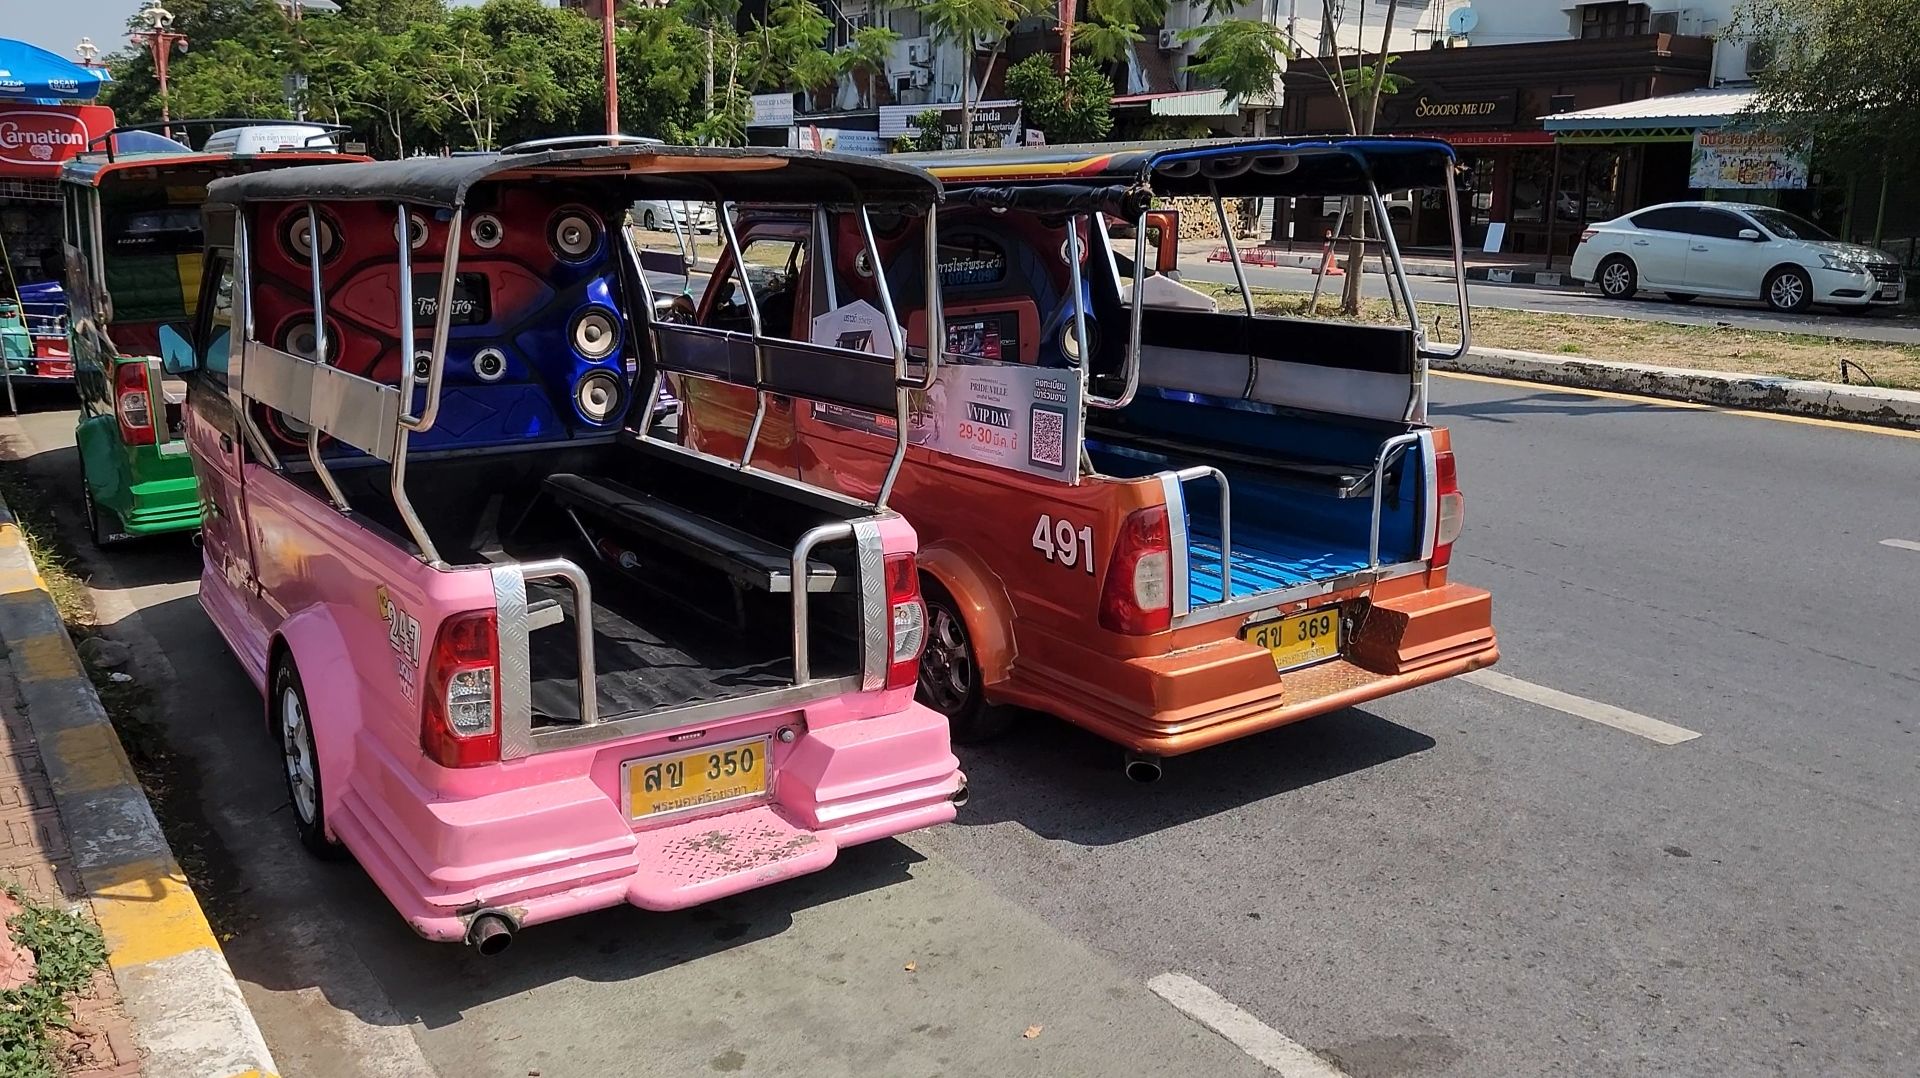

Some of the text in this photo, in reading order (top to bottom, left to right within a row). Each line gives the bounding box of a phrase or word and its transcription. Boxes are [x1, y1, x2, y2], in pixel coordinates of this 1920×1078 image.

[1415, 97, 1496, 117] SCOOPS ME UP
[0, 121, 83, 149] Carnation
[945, 124, 959, 133] Thai
[974, 123, 985, 132] and
[1033, 387, 1067, 403] เข้าร่วมงาน
[1034, 378, 1067, 391] ลงทะเบียน
[965, 403, 1011, 427] VVIP DAY
[959, 423, 992, 444] 29-30
[1031, 513, 1094, 574] 491
[1298, 615, 1330, 641] 369
[644, 748, 754, 793] สข 350
